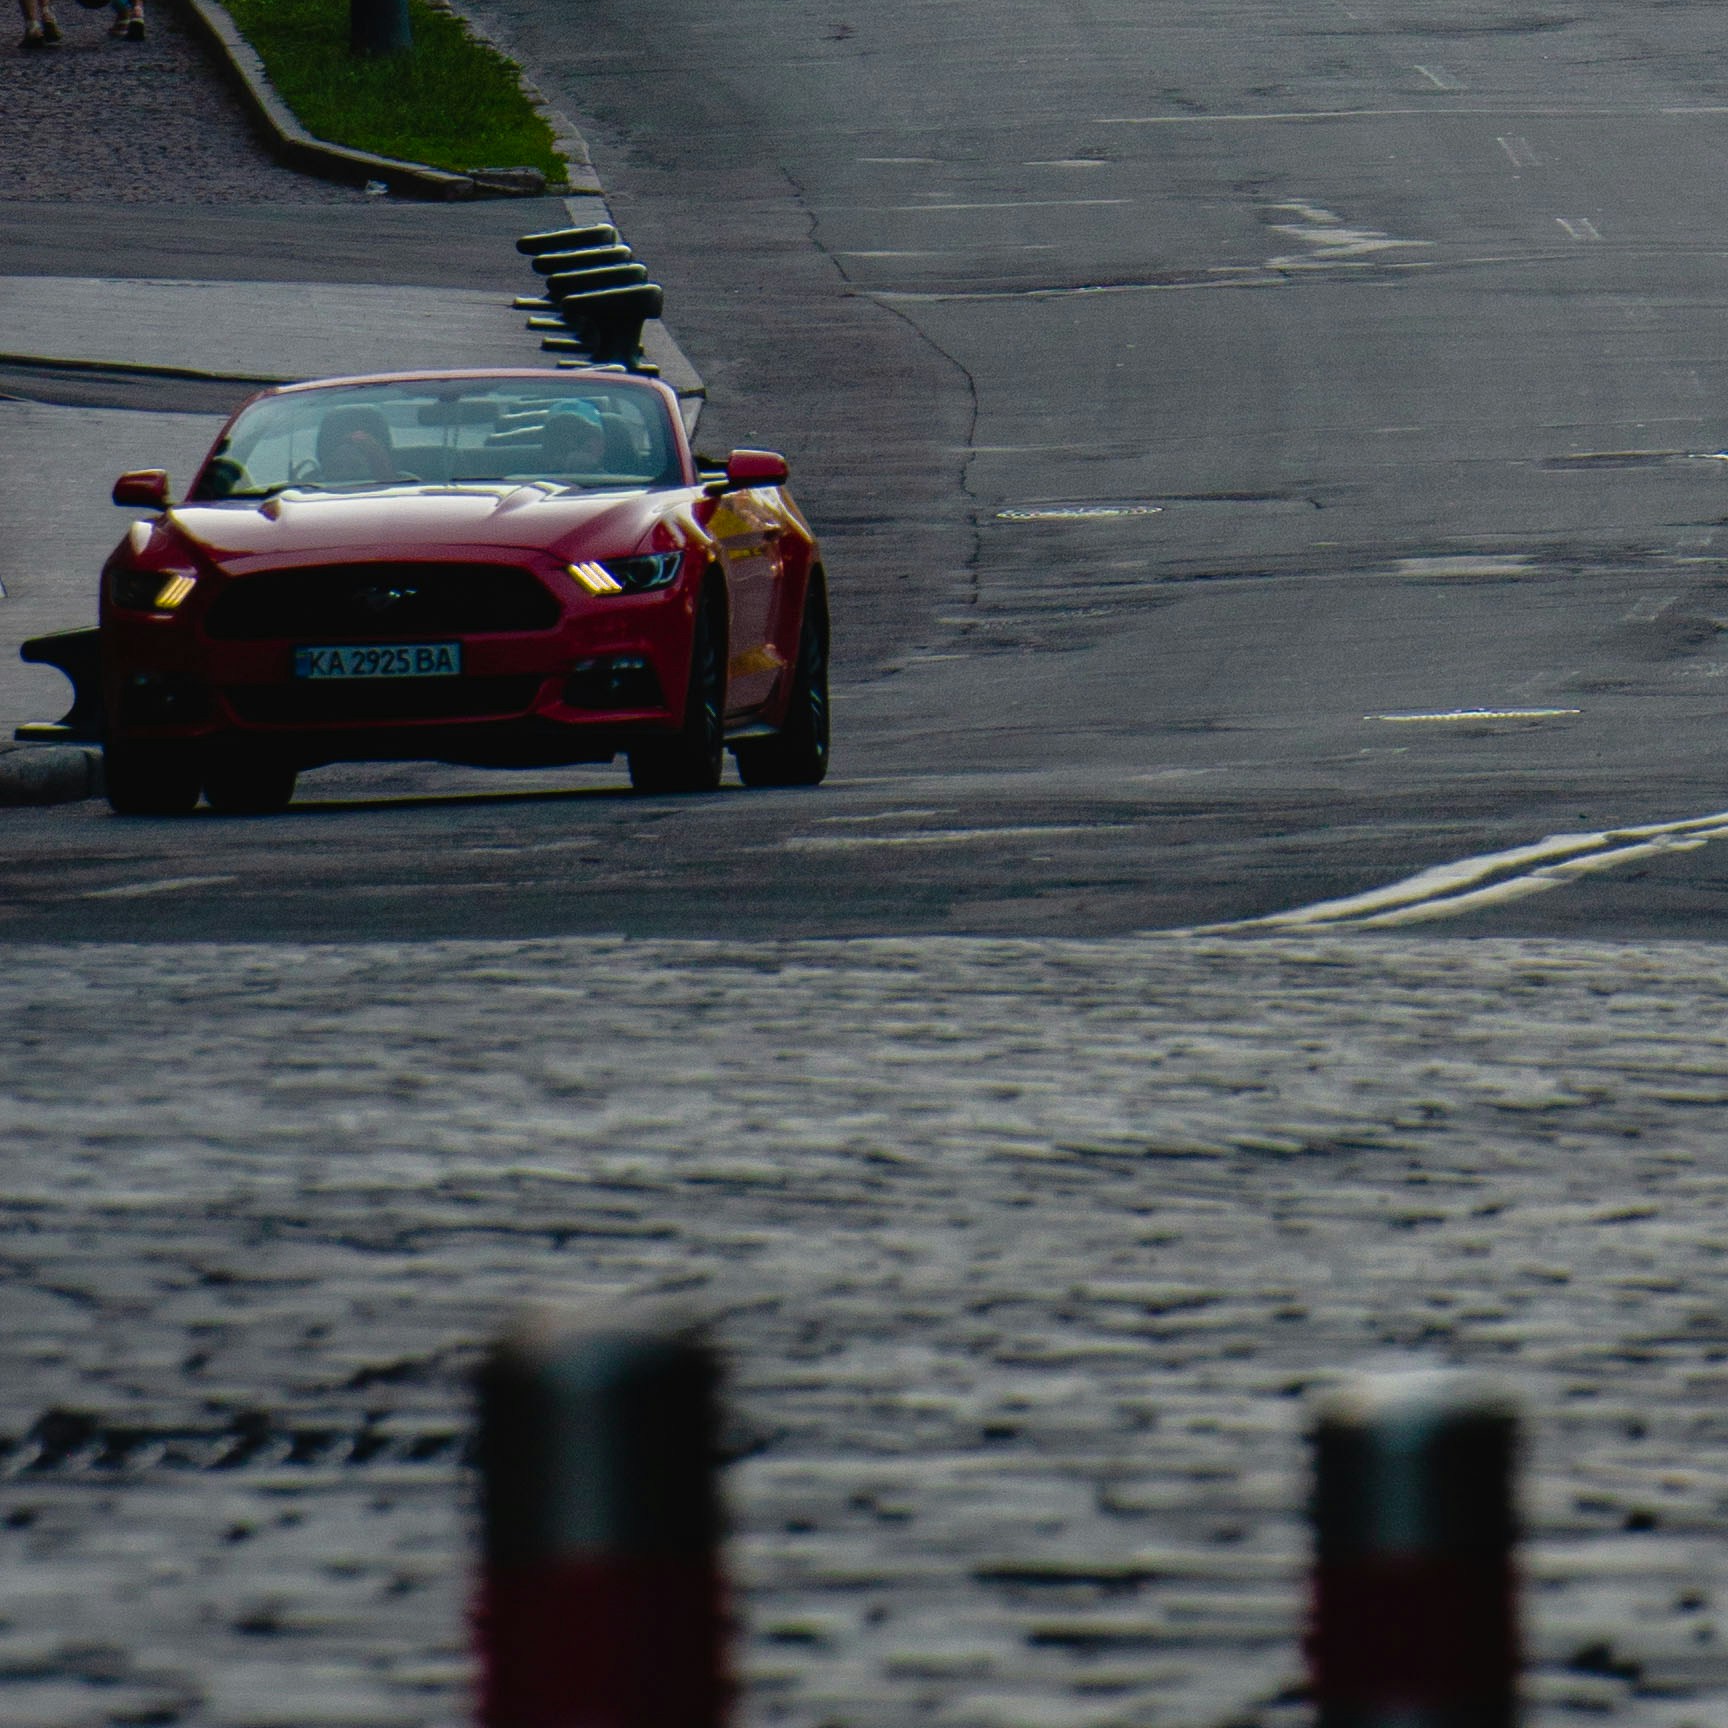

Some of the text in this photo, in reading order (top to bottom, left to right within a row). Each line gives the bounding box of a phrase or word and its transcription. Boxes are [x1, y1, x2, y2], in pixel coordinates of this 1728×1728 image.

[309, 647, 454, 675] KA 2925 BA
